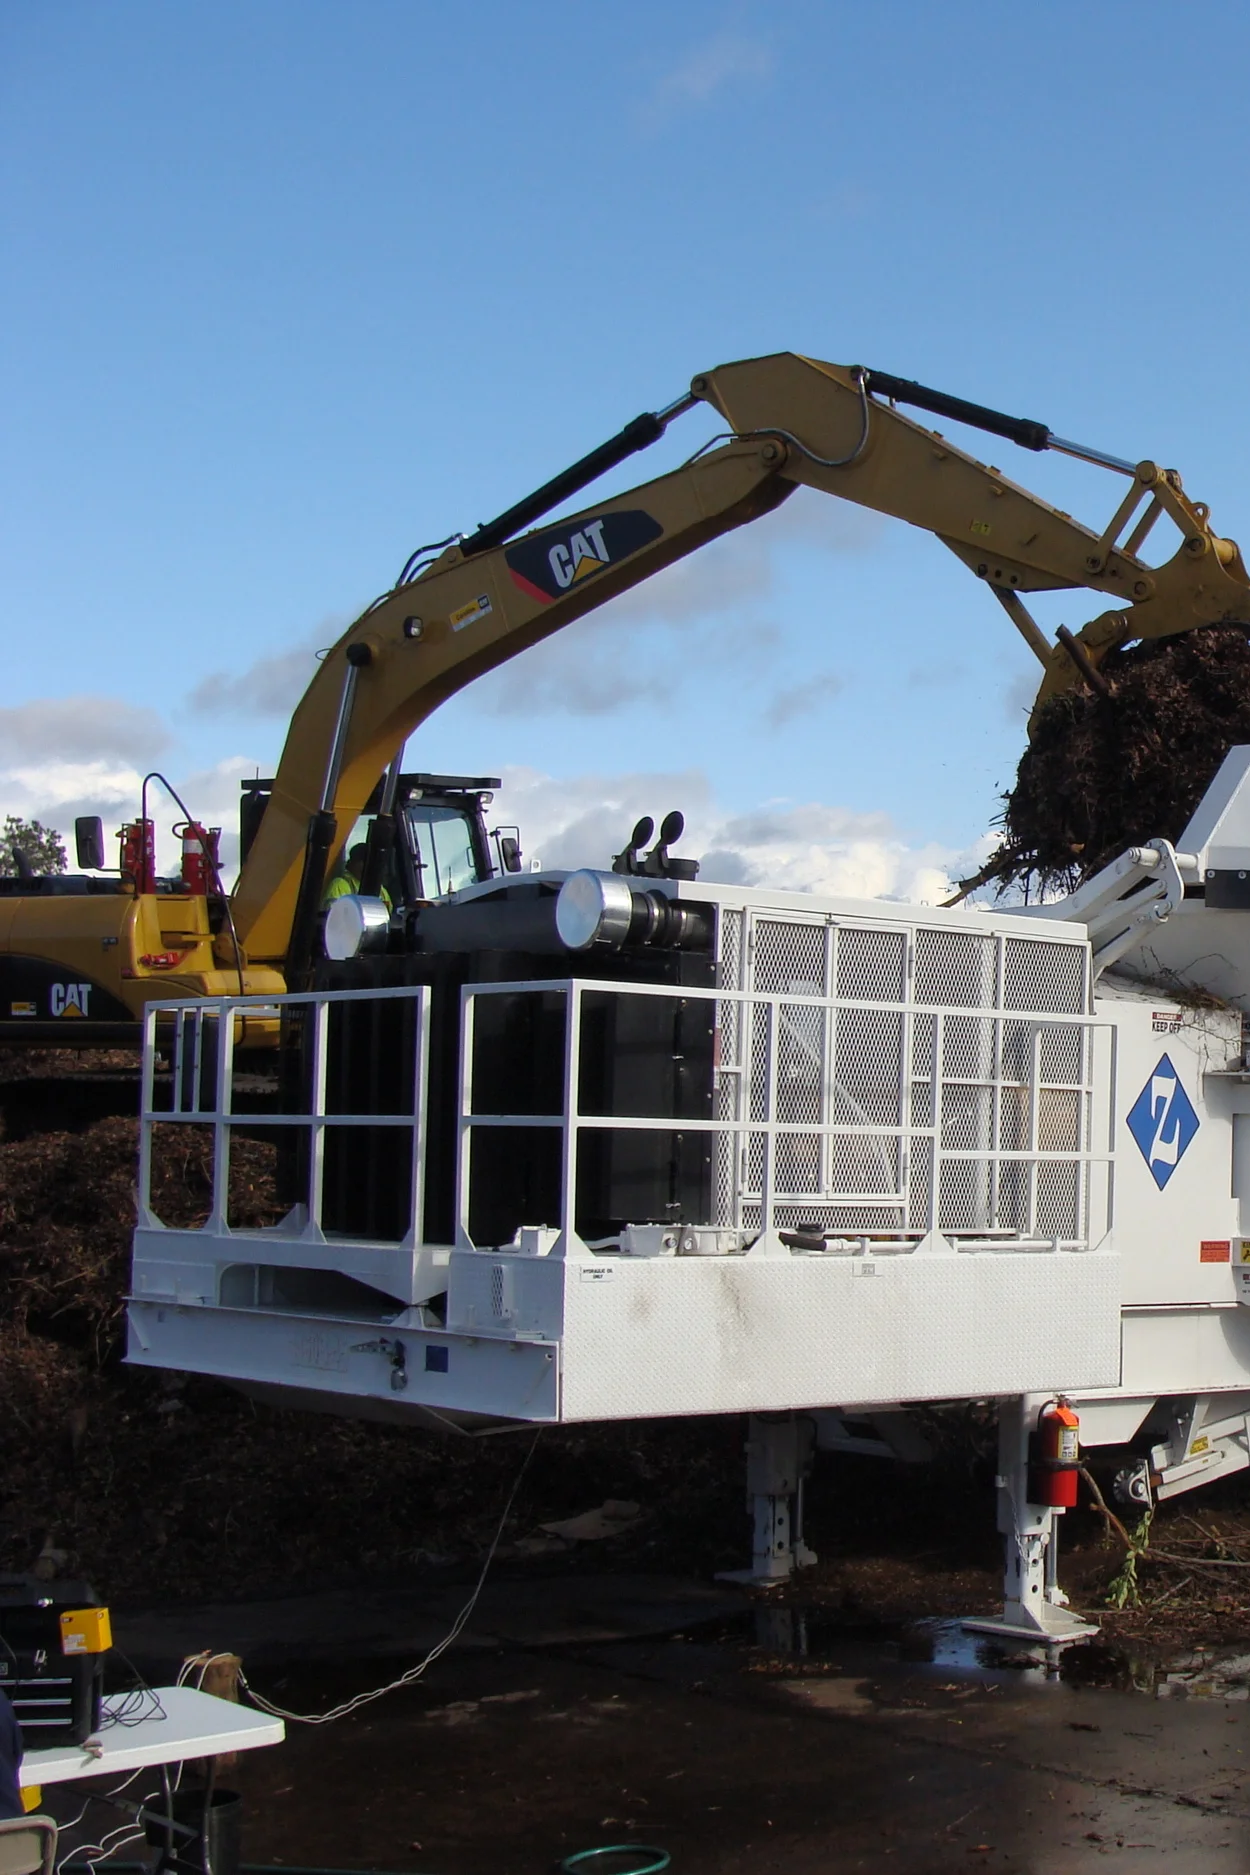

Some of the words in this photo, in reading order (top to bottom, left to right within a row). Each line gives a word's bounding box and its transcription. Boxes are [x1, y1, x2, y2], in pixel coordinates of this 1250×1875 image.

[548, 519, 610, 588] CAT
[51, 982, 92, 1017] CAT
[1152, 1021, 1168, 1032] KEEP
[1169, 1022, 1181, 1034] OFF
[1149, 1075, 1180, 1168] Z
